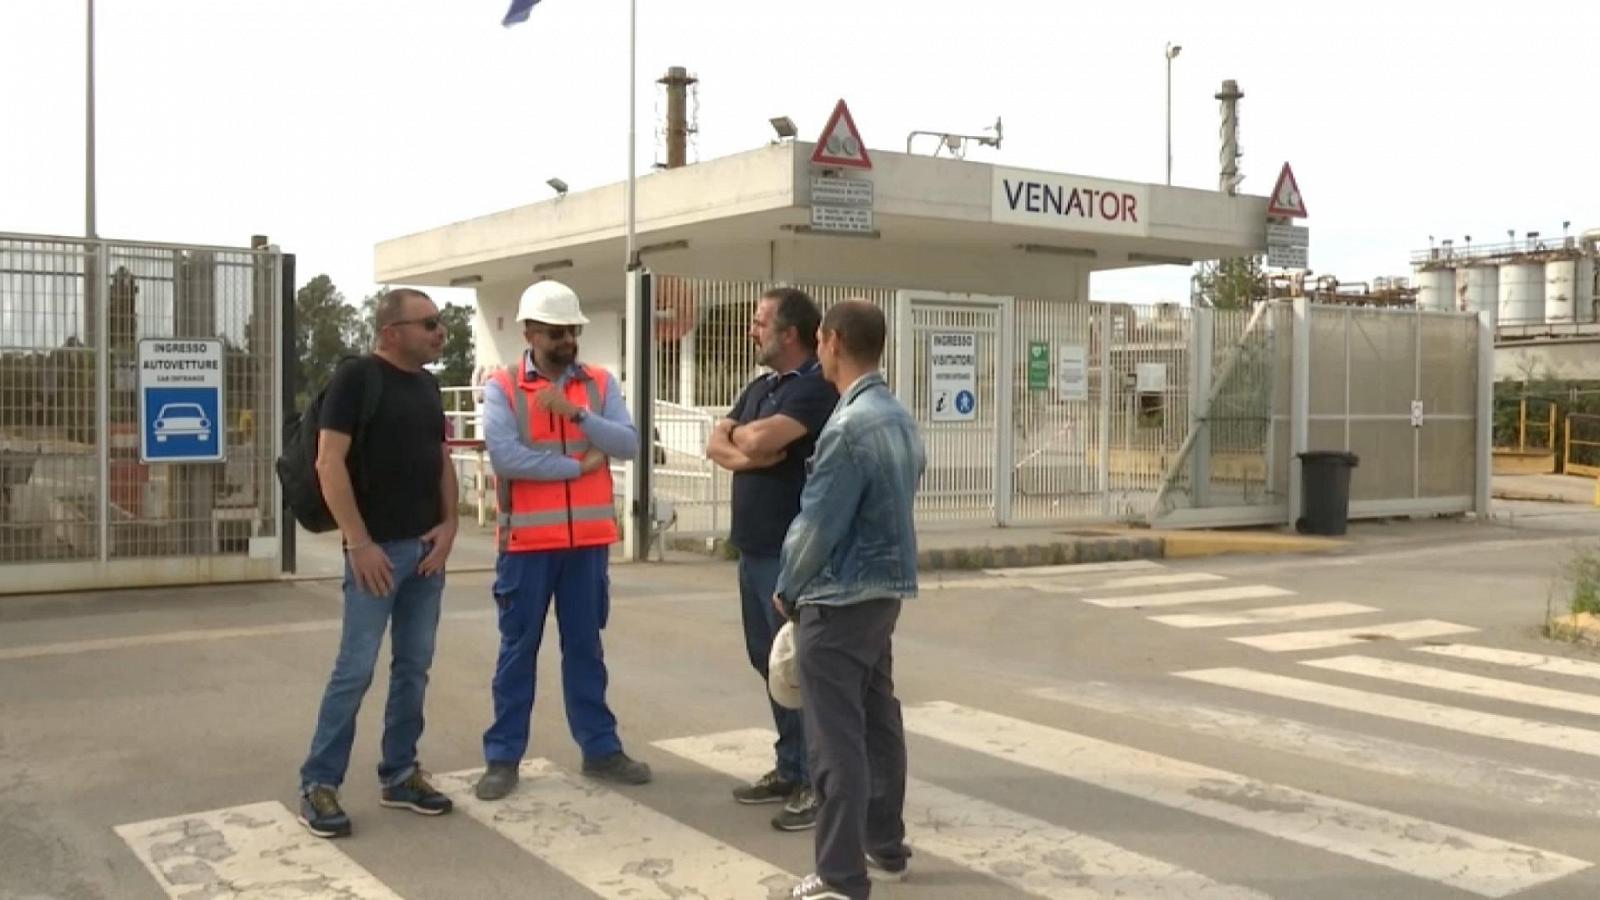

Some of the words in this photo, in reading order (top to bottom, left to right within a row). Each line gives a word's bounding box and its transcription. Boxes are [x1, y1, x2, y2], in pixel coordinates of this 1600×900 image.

[1003, 179, 1138, 223] VENATOR
[934, 335, 972, 347] INGRESSO
[153, 343, 208, 353] INGRESSO
[143, 360, 218, 370] AUTOVETTURE
[932, 354, 974, 366] VISITATORI
